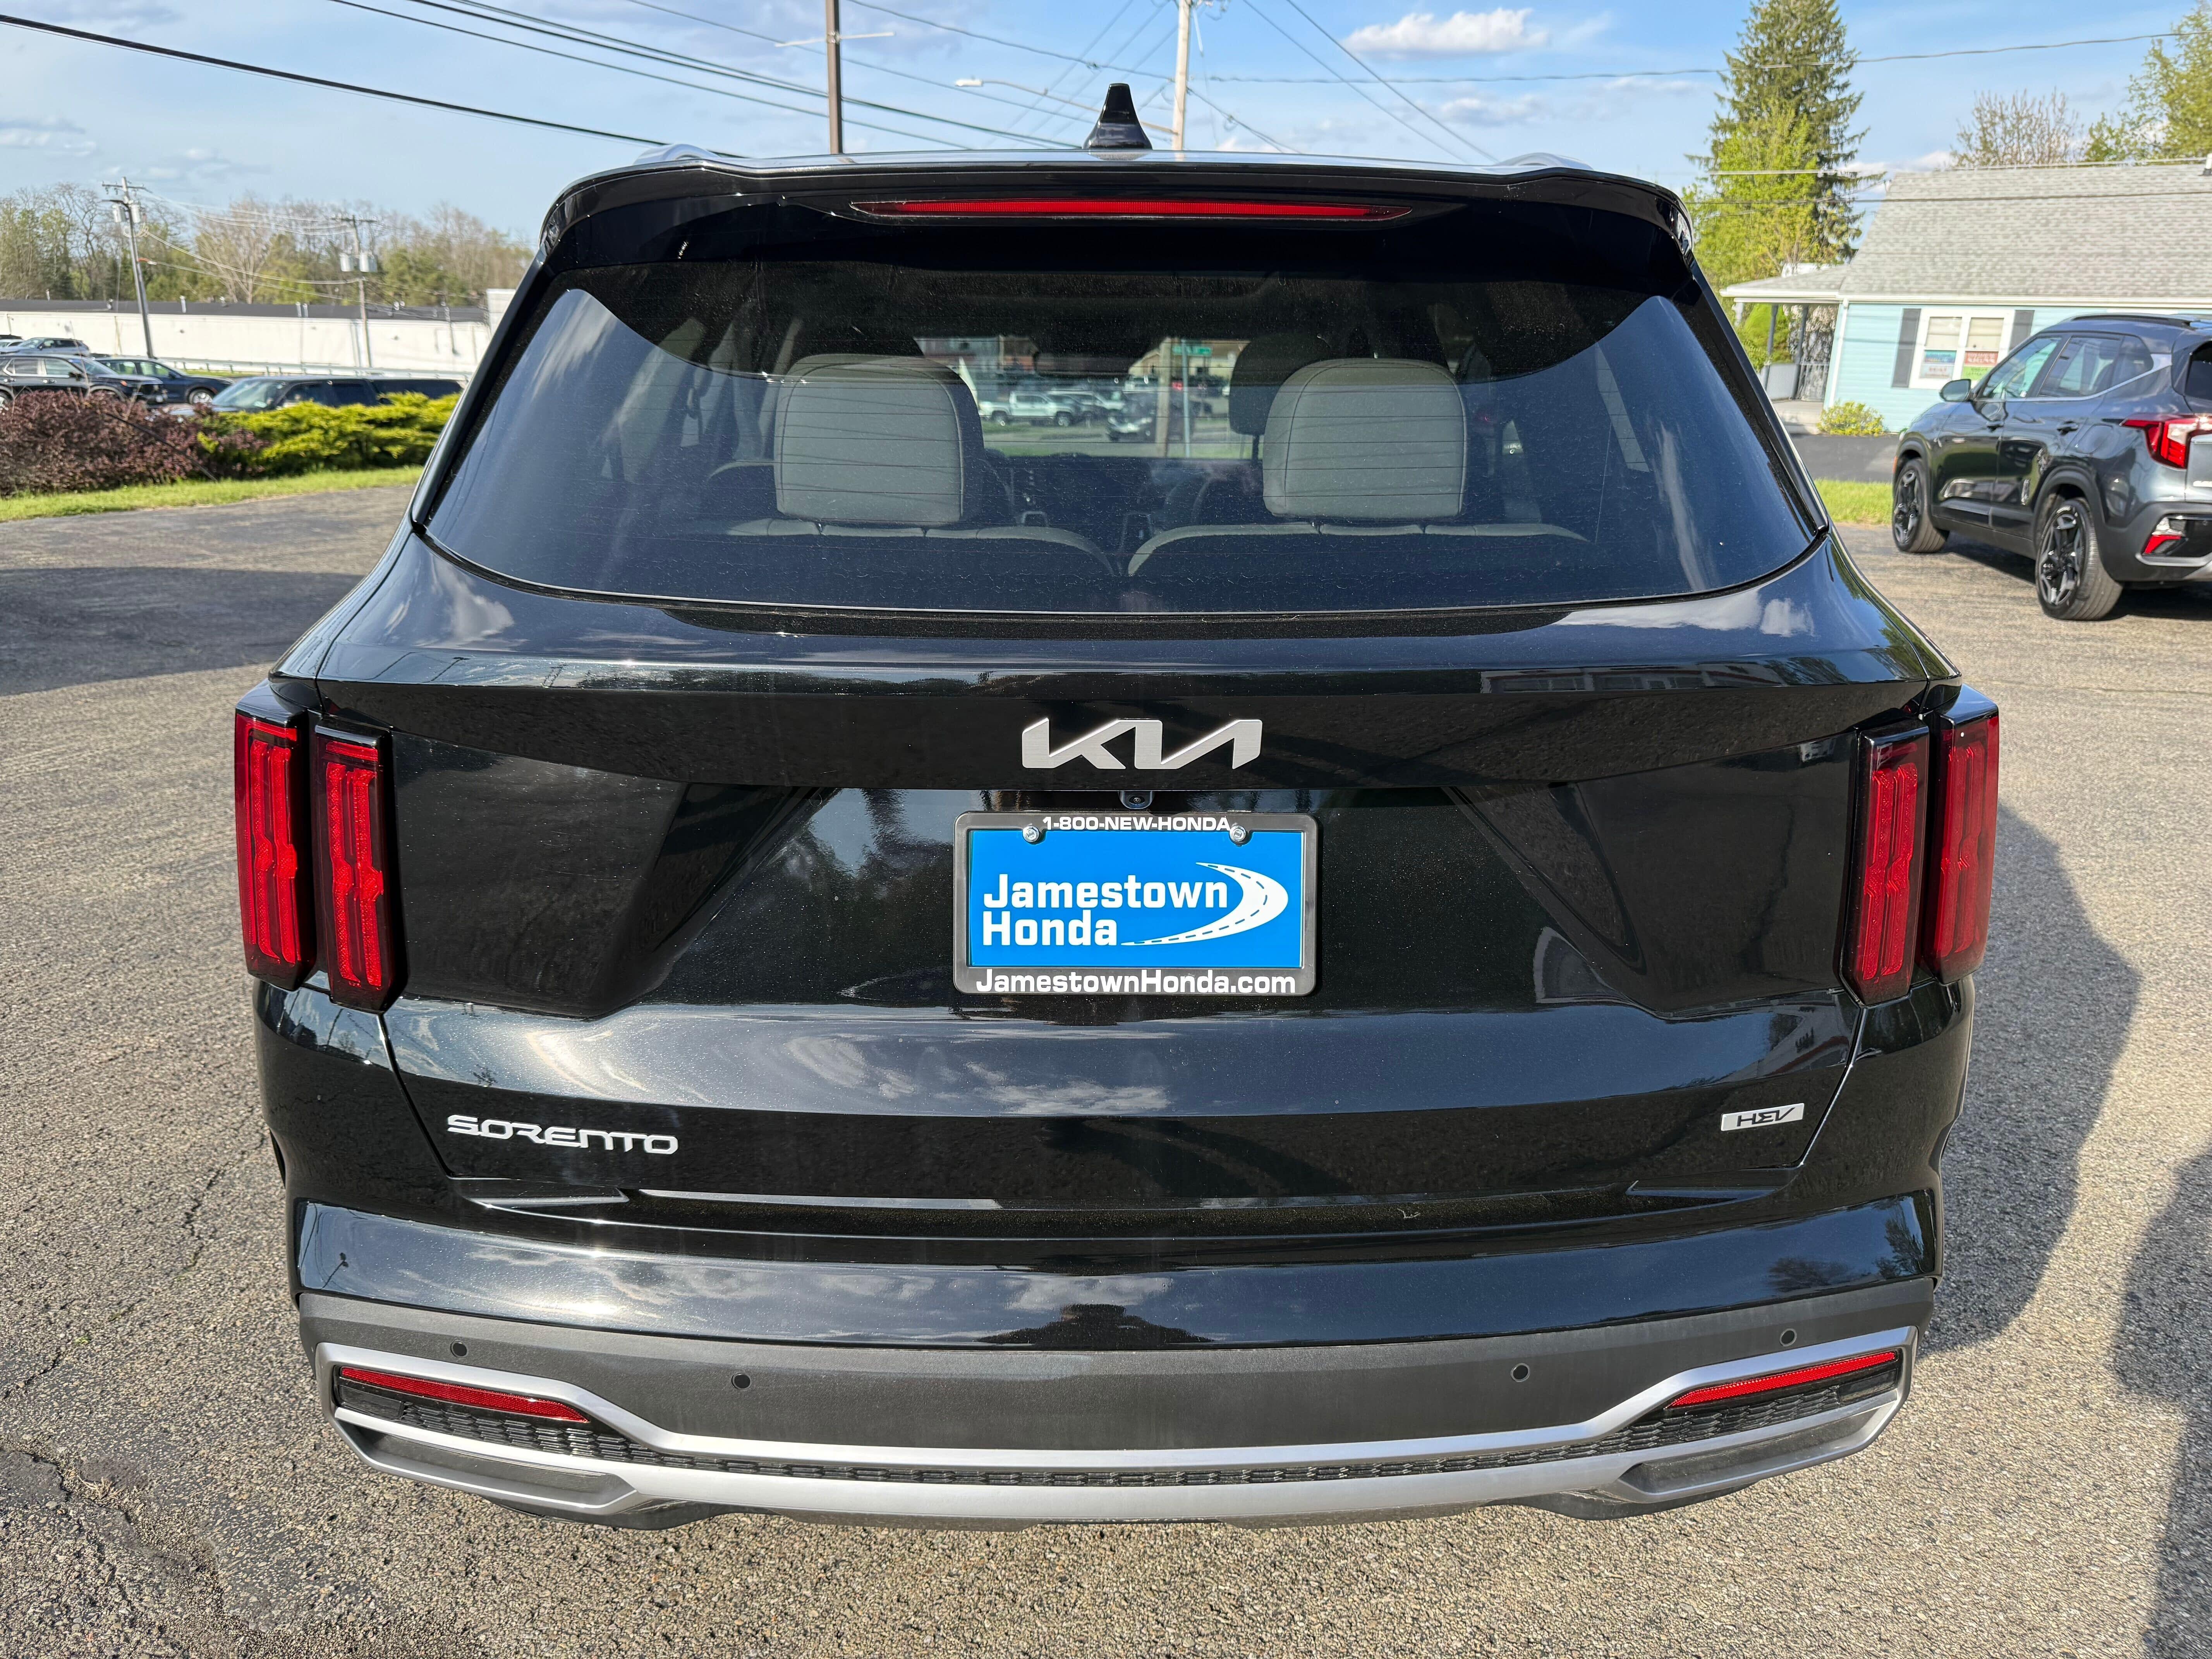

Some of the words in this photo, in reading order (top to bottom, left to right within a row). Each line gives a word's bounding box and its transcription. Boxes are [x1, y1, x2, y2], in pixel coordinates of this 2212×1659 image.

[1022, 717, 1263, 769] KIA
[1042, 816, 1231, 831] 1-800-NEW-HONDA
[984, 874, 1228, 908] Jamestown
[983, 910, 1117, 946] Honda
[976, 969, 1296, 993] JamestownHonda.com
[1736, 1107, 1795, 1127] HEV
[447, 1114, 678, 1155] SORENTO
